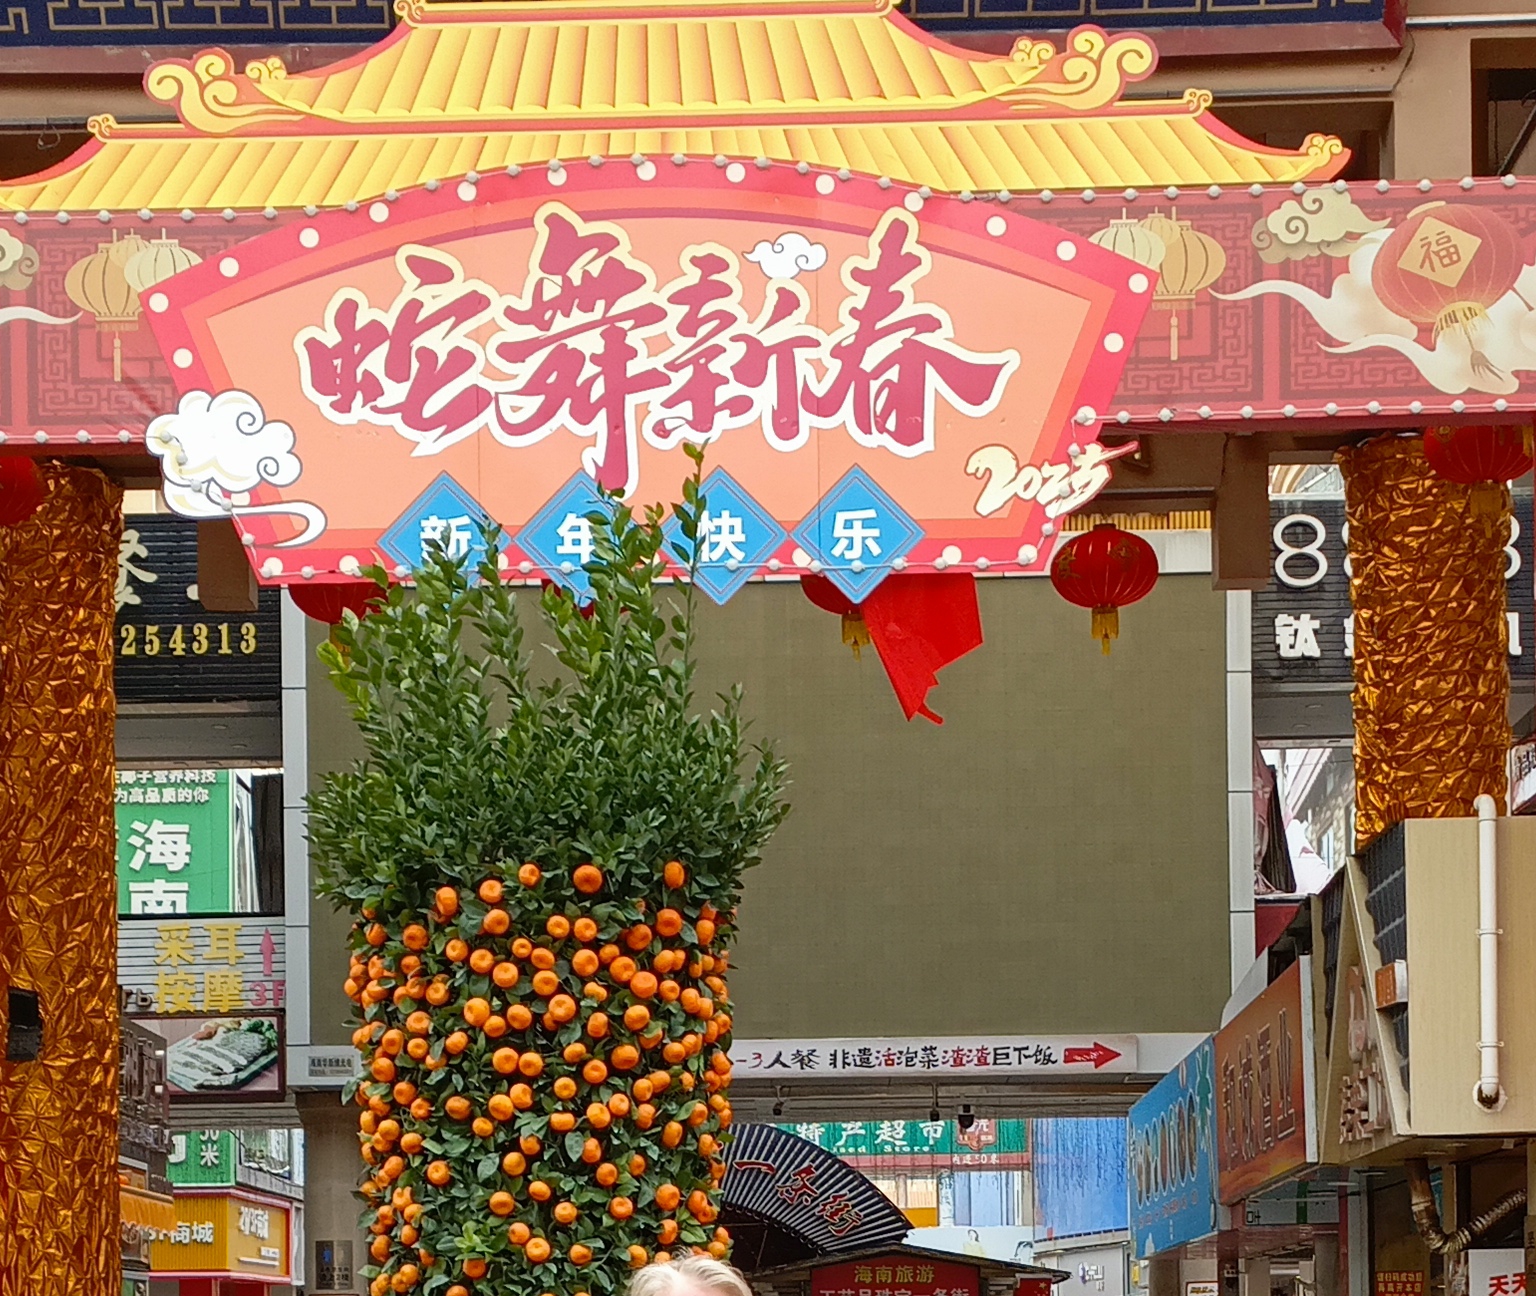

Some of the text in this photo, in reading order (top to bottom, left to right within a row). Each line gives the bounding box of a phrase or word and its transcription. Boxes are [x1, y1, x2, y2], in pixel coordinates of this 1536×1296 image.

[1417, 230, 1463, 272] 福
[300, 206, 1017, 493] 蛇舞新春
[966, 440, 1137, 517] 2025
[153, 922, 245, 967] 采耳
[154, 969, 245, 1014] 按摩
[249, 979, 286, 1007] 3F
[732, 1159, 864, 1238] 一条街
[853, 1264, 936, 1285] 海南旅游
